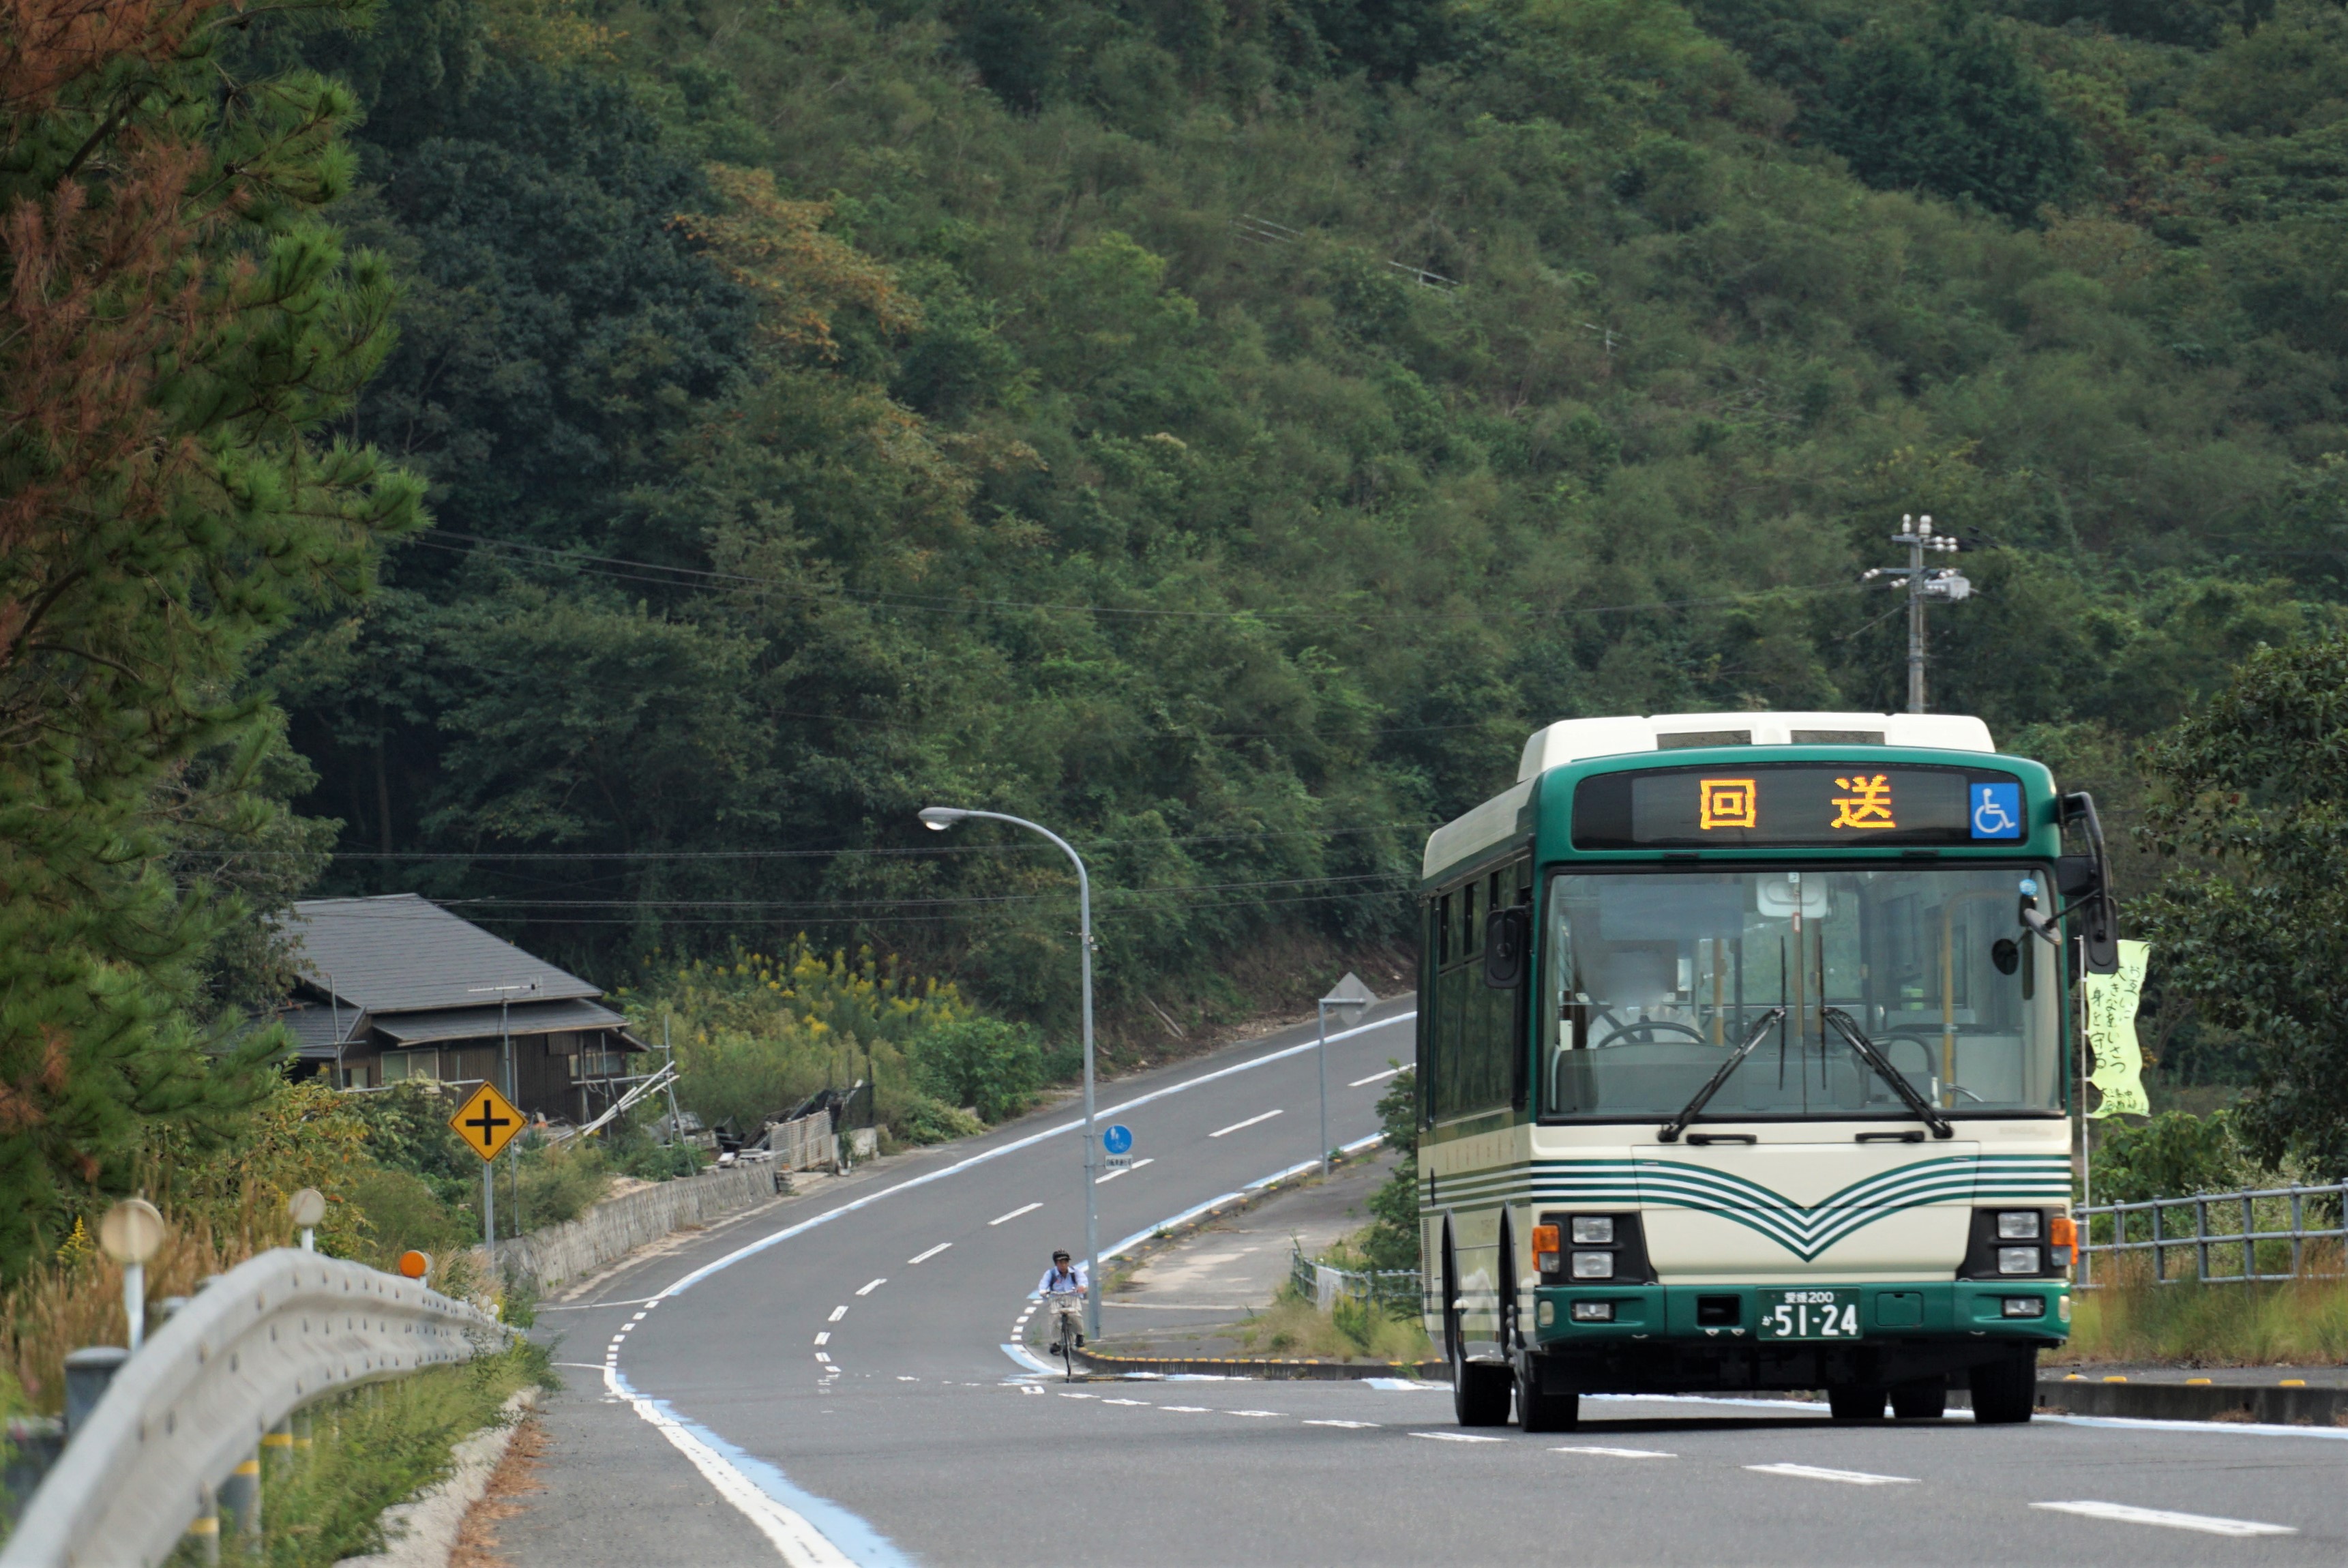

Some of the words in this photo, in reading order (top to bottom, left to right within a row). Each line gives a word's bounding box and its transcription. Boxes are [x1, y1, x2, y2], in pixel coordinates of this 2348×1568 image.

[2089, 987, 2107, 1069] 身を守る
[1774, 1304, 1858, 1336] 51-24
